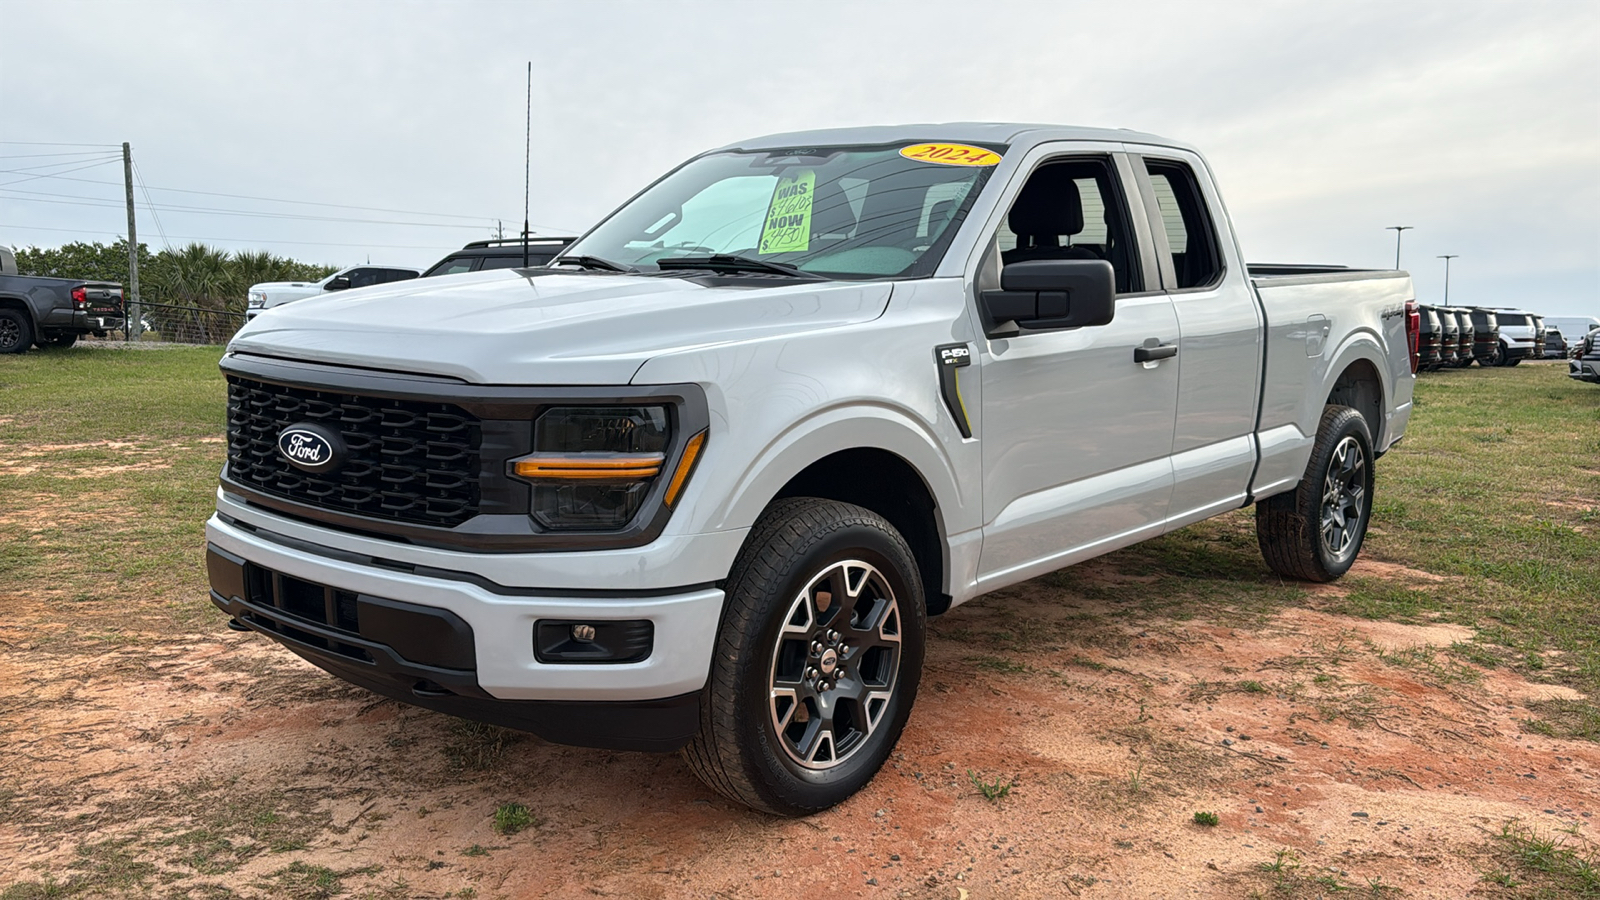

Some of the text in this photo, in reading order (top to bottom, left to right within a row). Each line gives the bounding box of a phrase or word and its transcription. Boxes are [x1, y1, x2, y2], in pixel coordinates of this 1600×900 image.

[911, 146, 990, 162] 2024
[778, 183, 807, 200] WAS
[768, 213, 805, 230] NOW
[941, 348, 969, 359] F-150
[288, 434, 321, 461] Ford
